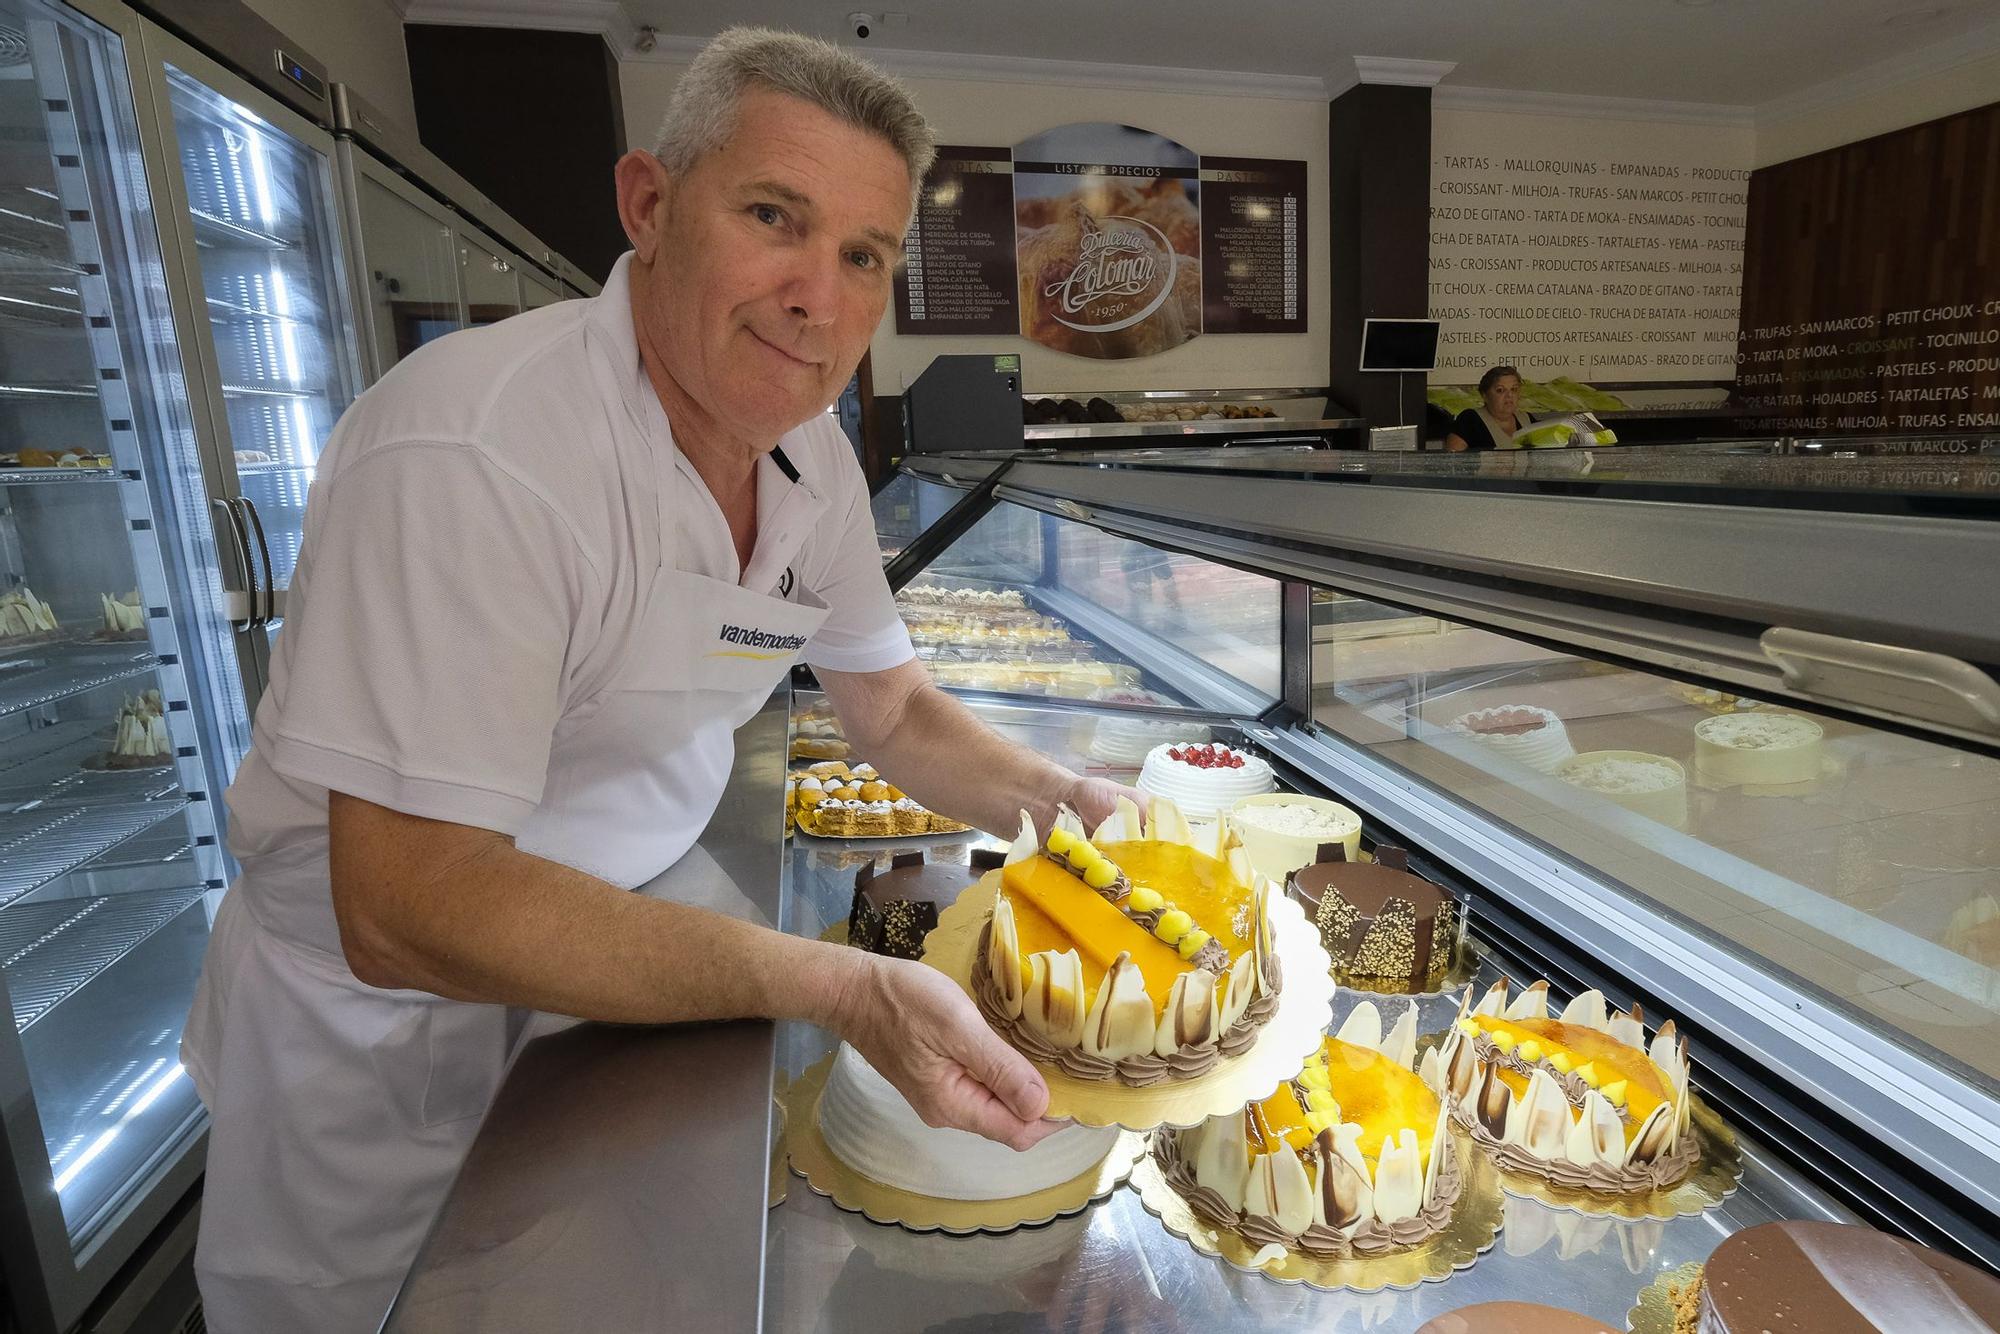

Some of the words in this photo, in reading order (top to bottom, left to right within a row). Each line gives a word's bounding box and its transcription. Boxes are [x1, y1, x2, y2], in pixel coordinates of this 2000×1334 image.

[1055, 164, 1085, 175] LISTA
[1112, 167, 1161, 177] PRECIOS
[1444, 156, 1489, 169] TARTAS
[1504, 159, 1597, 175] MALLORQUINAS
[1611, 164, 1679, 178] EMPANADAS
[1440, 182, 1503, 195] CROISSANT
[1512, 185, 1559, 197] MILHOJA
[1568, 186, 1608, 199] TRUFAS
[1617, 188, 1637, 200] SAN
[1640, 190, 1683, 202] MARCOS
[1692, 192, 1717, 203] PETIT
[1464, 209, 1477, 220] DE
[1481, 209, 1524, 221] GITANO
[1534, 210, 1568, 222] TARTA
[1571, 212, 1584, 222] DE
[1587, 212, 1620, 223] MOKA
[1629, 213, 1695, 226] ENSAIMADAS
[1431, 233, 1455, 245] CHA
[1459, 234, 1473, 245] DE
[1477, 234, 1519, 245] BATATA
[1529, 235, 1588, 247] HOJALDRES
[1598, 236, 1659, 249] TARTALETAS
[1669, 238, 1698, 250] YEMA
[1461, 258, 1523, 270] CROISSANT
[1532, 259, 1597, 271] PRODUCTOS
[1600, 261, 1670, 272] ARTESANALES
[1679, 263, 1722, 273] MILHOJA
[1444, 283, 1486, 295] CHOUX
[1496, 284, 1534, 295] CREMA
[1537, 283, 1593, 295] CATALANA
[1603, 284, 1637, 296] BRAZO
[1640, 285, 1652, 296] DE
[1655, 286, 1694, 296] GITANO
[1704, 286, 1733, 296] TARTA
[1095, 302, 1124, 317] 1950
[1480, 308, 1533, 319] TOCINILLO
[1537, 309, 1549, 319] DE
[1552, 308, 1581, 319] CIELO
[1590, 308, 1631, 319] TRUCHA
[1634, 308, 1646, 319] DE
[1649, 309, 1686, 319] BATATA
[1496, 332, 1560, 343] PRODUCTOS
[1563, 331, 1633, 343] ARTESANALES
[1641, 331, 1696, 342] CROISSANT
[1704, 331, 1747, 342] MILHOJA
[1754, 325, 1792, 340] TRUFAS
[1800, 322, 1821, 335] SAN
[1824, 316, 1874, 332] MARCOS
[1886, 310, 1920, 326] PETIT
[1923, 304, 1973, 322] CHOUX
[1499, 356, 1527, 367] PETIT
[1530, 356, 1569, 366] CHOUX
[1657, 355, 1689, 365] BRAZO
[1693, 355, 1704, 365] DE
[1708, 353, 1745, 365] GITANO
[1753, 350, 1784, 362] TARTA
[1787, 348, 1800, 360] DE
[1803, 345, 1838, 358] MOKA
[1847, 336, 1916, 355] CROISSANT
[1927, 329, 1999, 348] TOCINILLO
[1745, 373, 1783, 386] BATATA
[1792, 366, 1865, 382] ENSAIMADAS
[1877, 361, 1936, 377] PASTELES
[1764, 394, 1803, 407] BATATA
[1812, 391, 1878, 405] HOJALDRES
[1888, 386, 1969, 402] TARTALETAS
[1760, 418, 1828, 430] ARTESANALES
[1836, 415, 1888, 429] MILHOJA
[1899, 414, 1947, 427] TRUFAS
[1911, 440, 1968, 453] MARCOS
